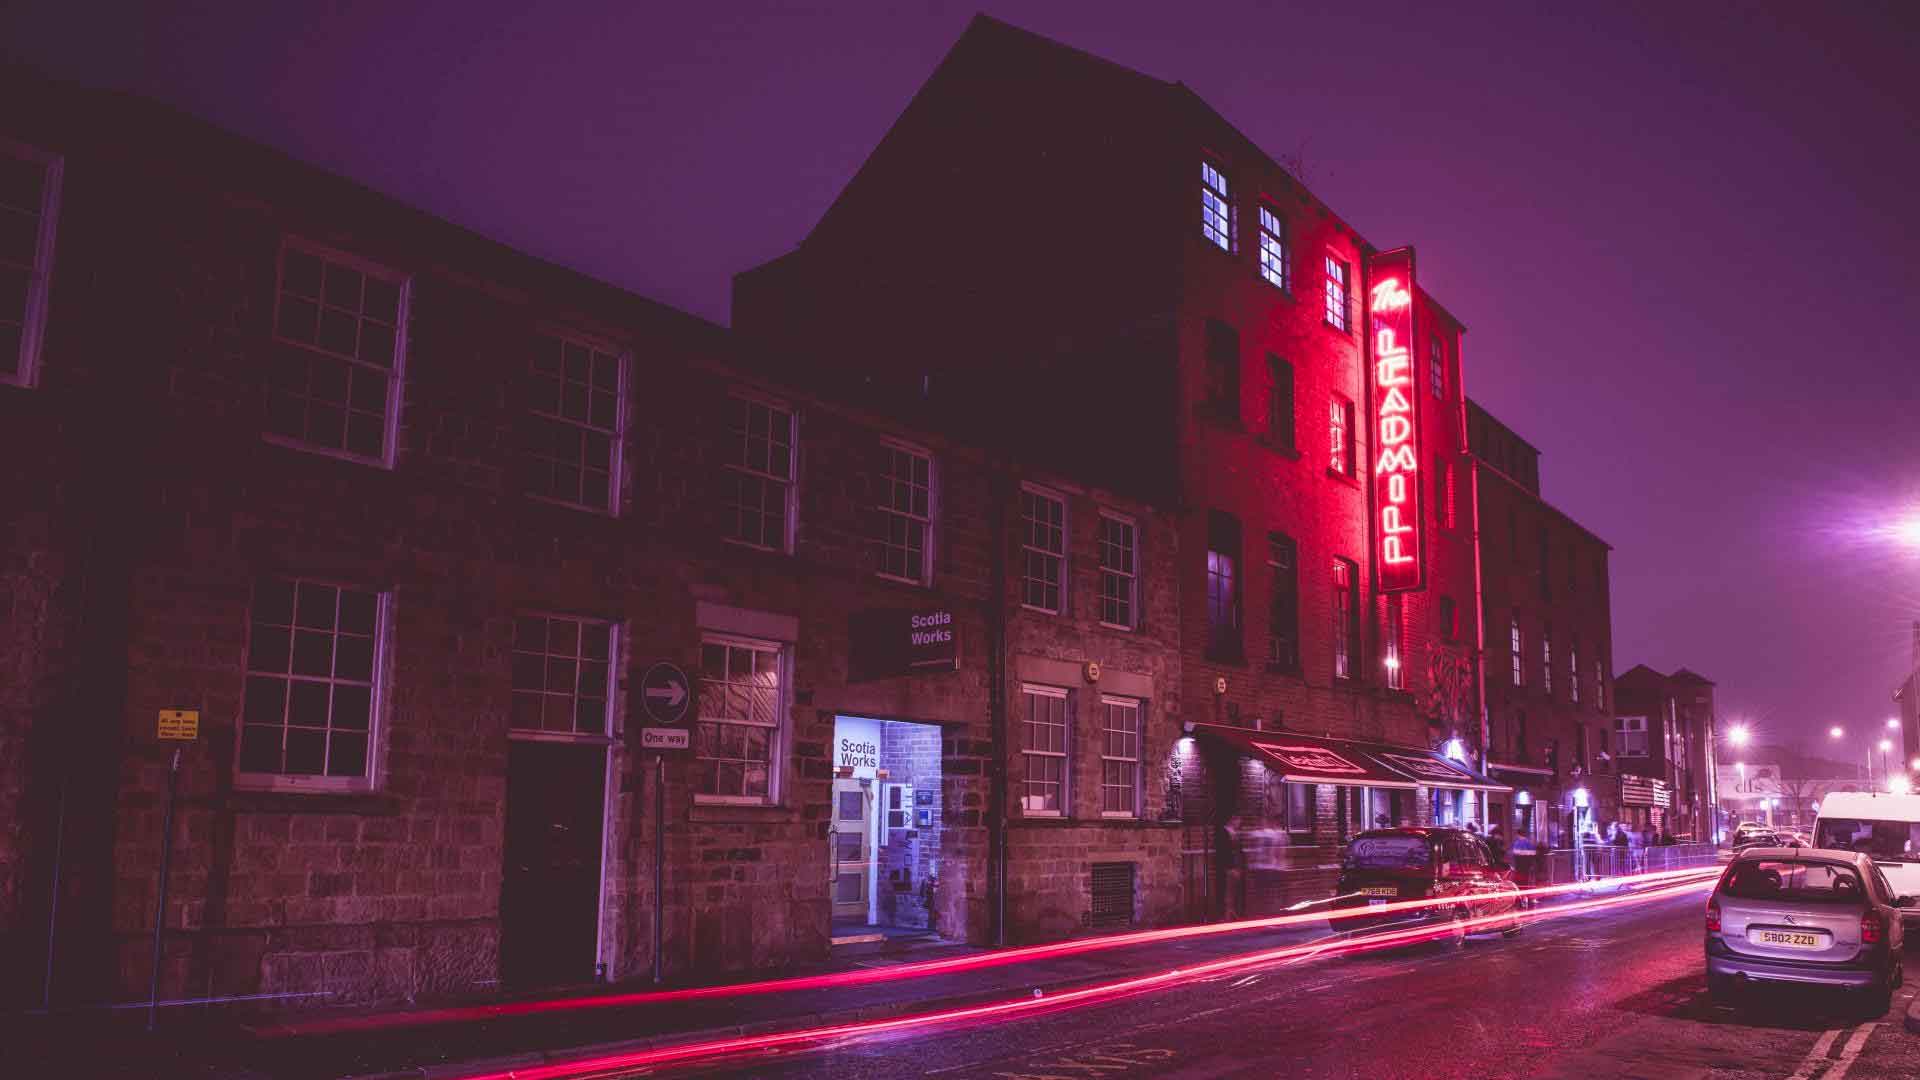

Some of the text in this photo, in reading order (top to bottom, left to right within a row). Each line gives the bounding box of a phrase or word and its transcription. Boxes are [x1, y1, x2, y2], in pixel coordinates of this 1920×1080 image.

[1372, 277, 1411, 312] The
[1376, 328, 1417, 564] LEADMILL
[911, 611, 952, 628] Scotia
[911, 630, 952, 646] Works
[644, 732, 687, 745] One way
[841, 738, 876, 755] Scotia
[841, 752, 876, 768] Works
